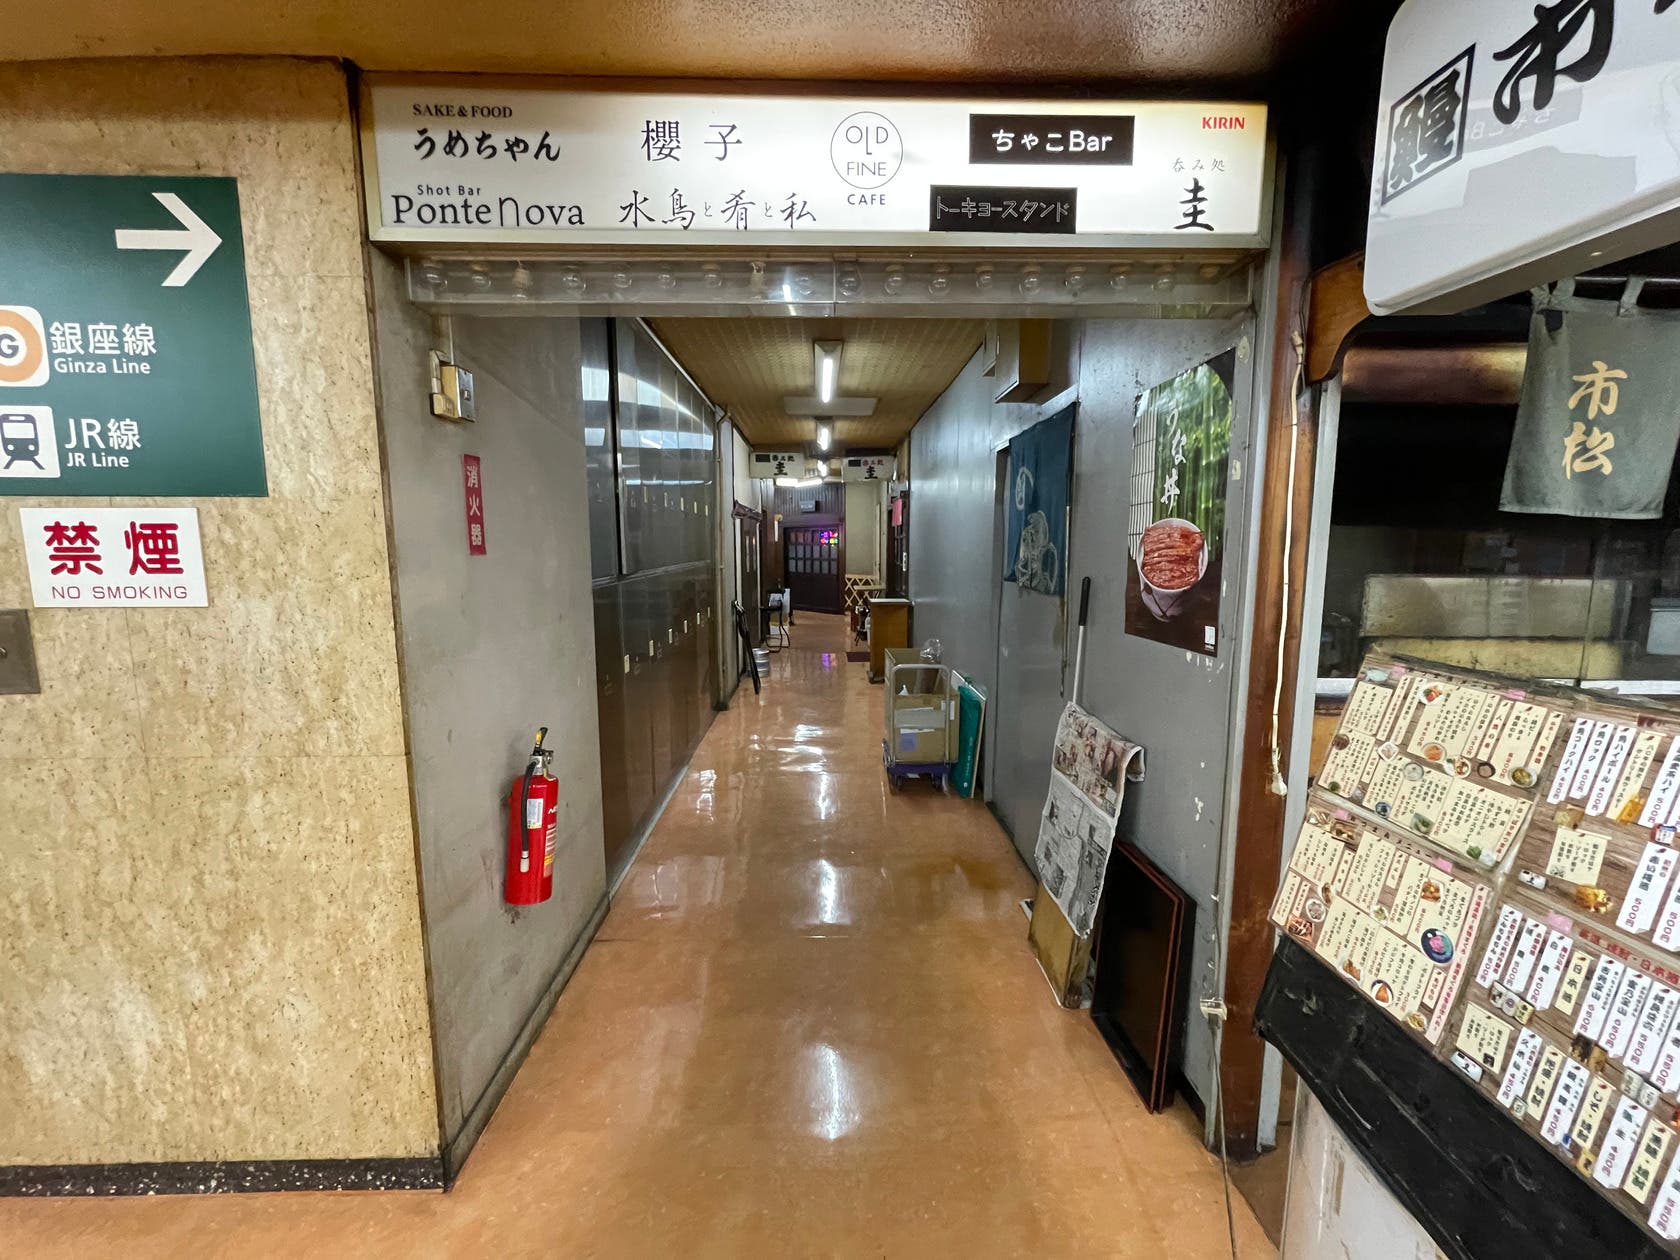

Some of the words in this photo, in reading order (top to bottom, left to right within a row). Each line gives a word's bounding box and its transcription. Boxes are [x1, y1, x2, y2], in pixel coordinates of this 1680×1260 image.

[1201, 116, 1246, 130] KIRIN
[413, 130, 561, 161] うめちゃん
[846, 124, 889, 156] OLD
[991, 129, 1113, 153] ちゃこBar
[846, 161, 887, 177] FINE
[1171, 158, 1226, 173] 呑み処
[417, 184, 451, 196] Shot
[457, 185, 482, 197] Bar
[847, 193, 886, 206] CAFE
[1172, 177, 1216, 231] 圭
[618, 187, 817, 231] 水鳥と肴と私
[936, 195, 1071, 223] トーキョースタンド
[49, 321, 157, 356] 銀座線
[54, 357, 107, 374] Ginza
[112, 358, 151, 375] Line
[64, 417, 142, 451] JR線
[1561, 360, 1628, 480] 市松
[66, 452, 86, 467] JR
[92, 453, 130, 468] Line
[466, 465, 482, 546] 消火器
[43, 520, 184, 576] 禁煙
[51, 585, 82, 600] NO
[92, 585, 188, 600] SMOKING
